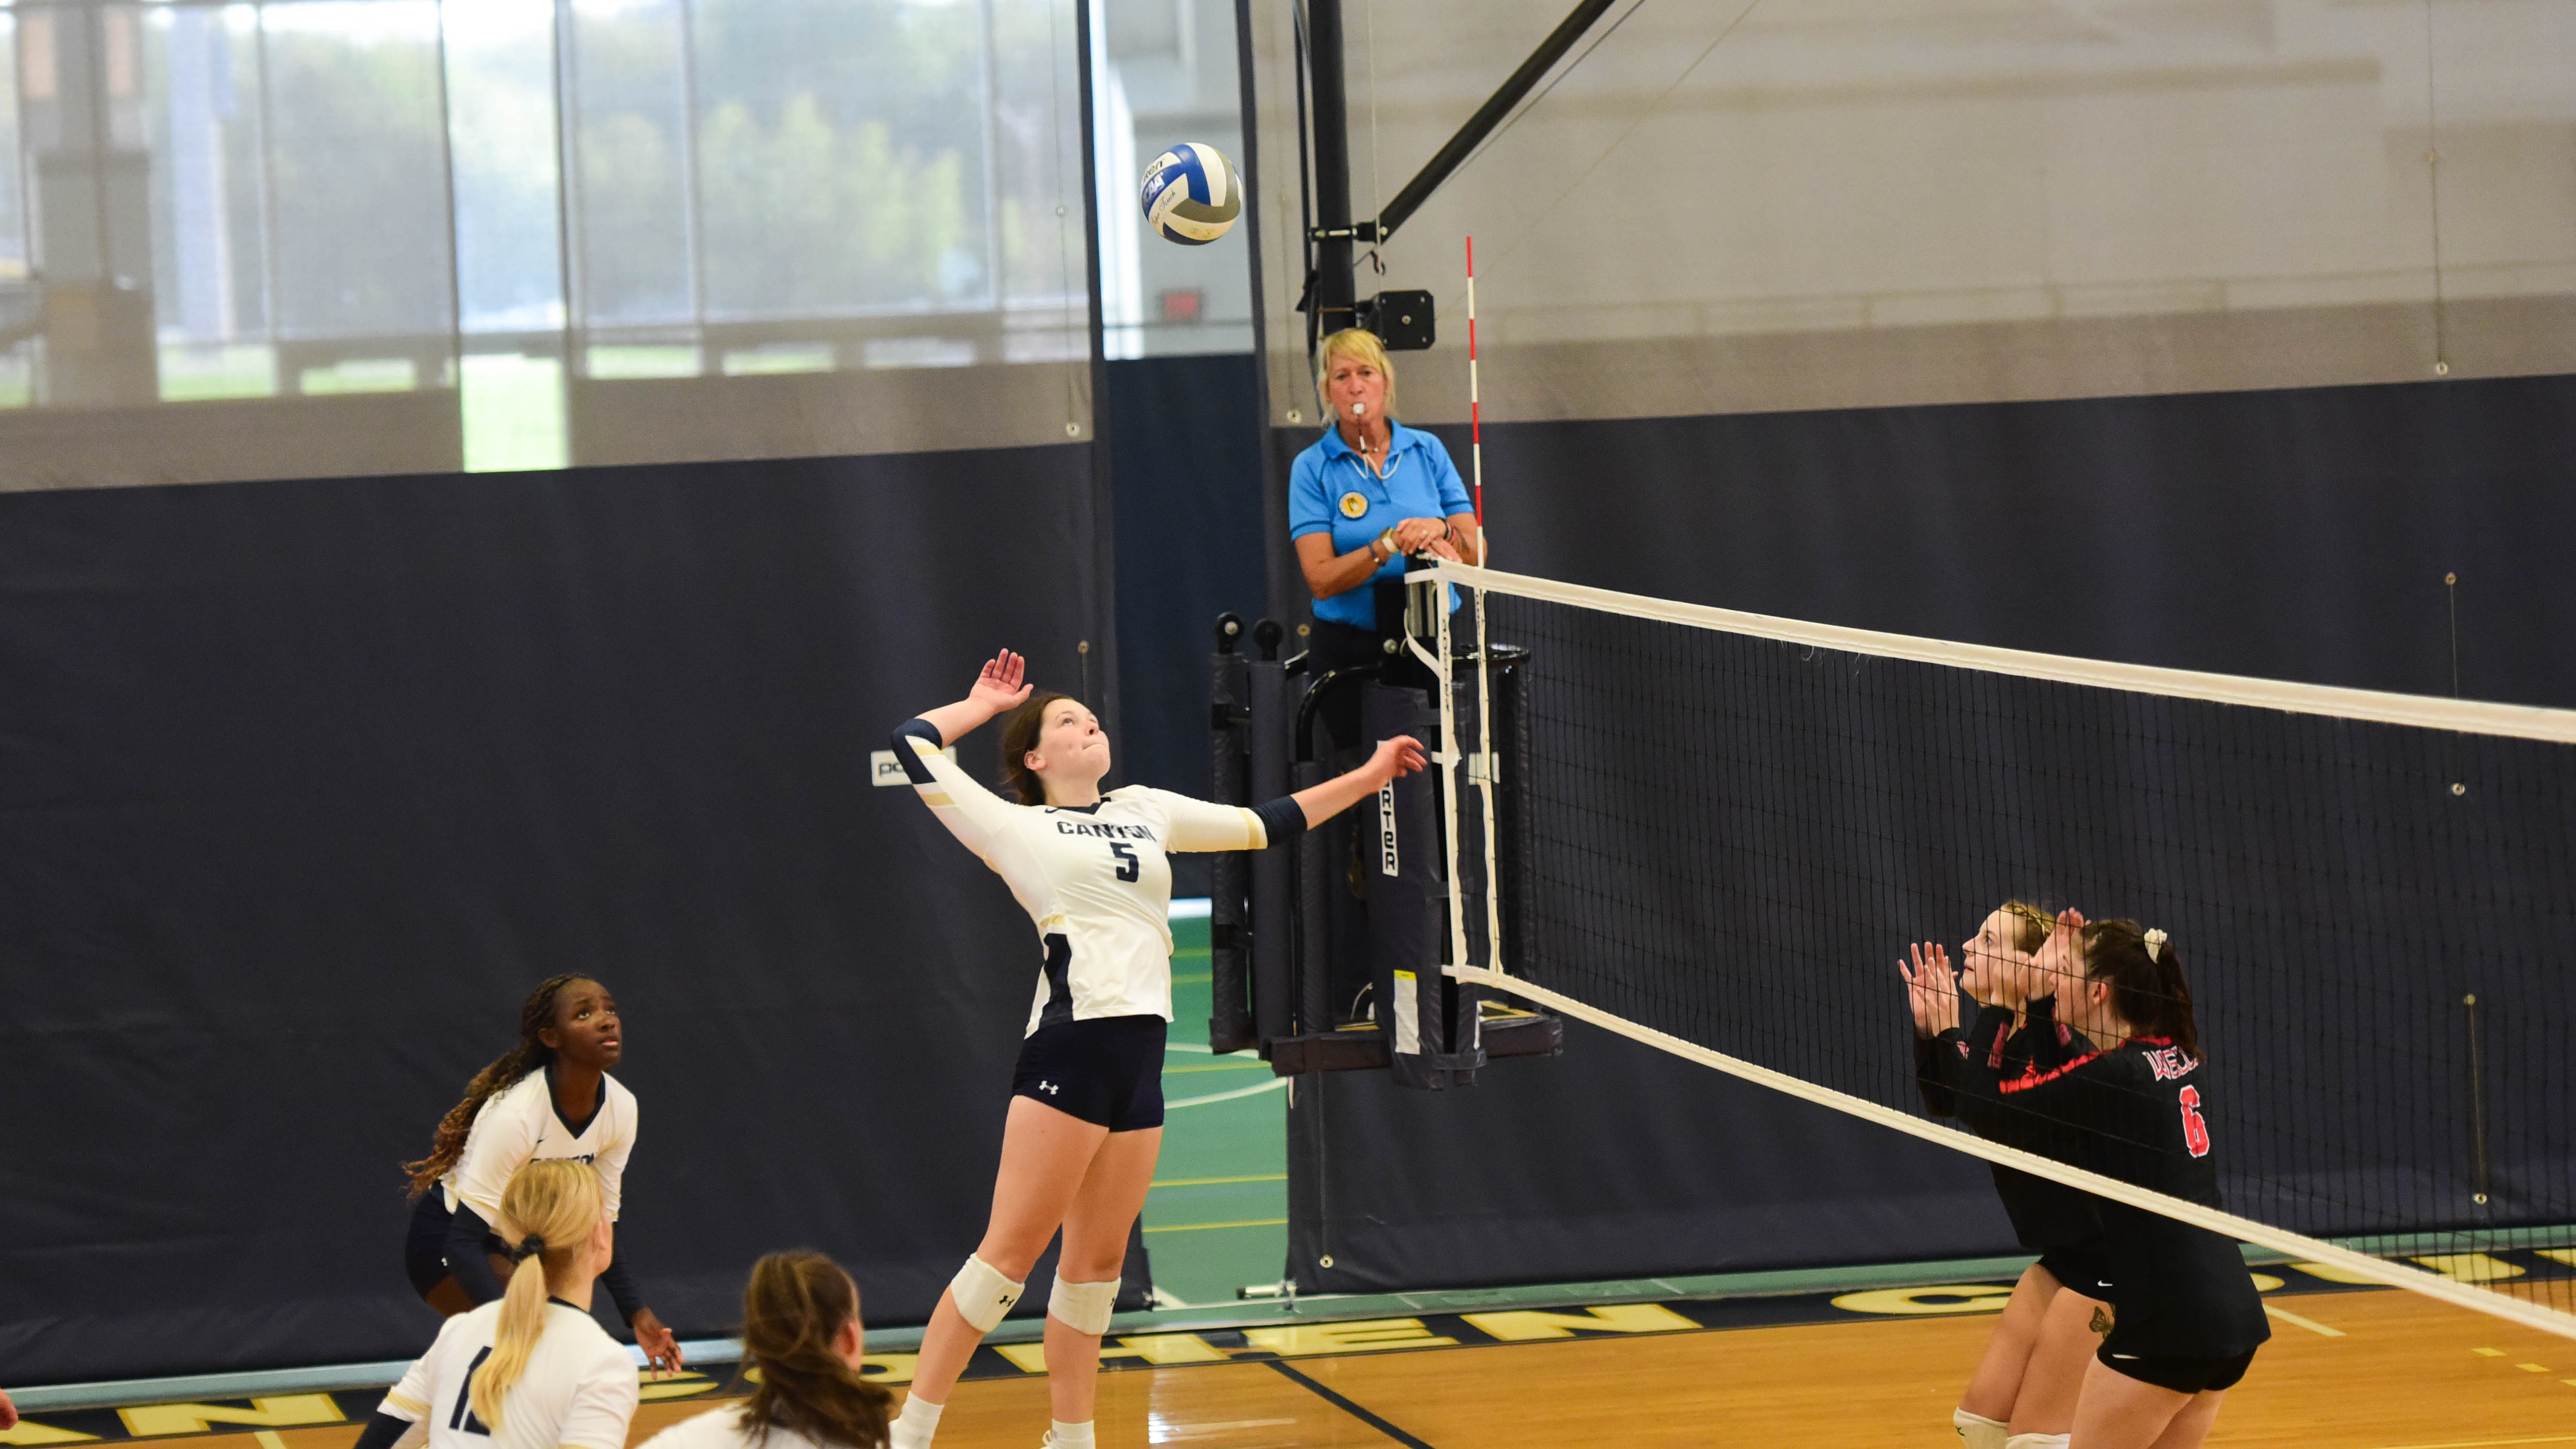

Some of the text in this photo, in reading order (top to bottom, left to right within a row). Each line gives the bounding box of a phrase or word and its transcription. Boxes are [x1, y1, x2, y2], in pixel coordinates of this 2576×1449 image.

[1109, 841, 1139, 883] 5
[2142, 1045, 2199, 1082] WELL
[2179, 1084, 2210, 1158] 6
